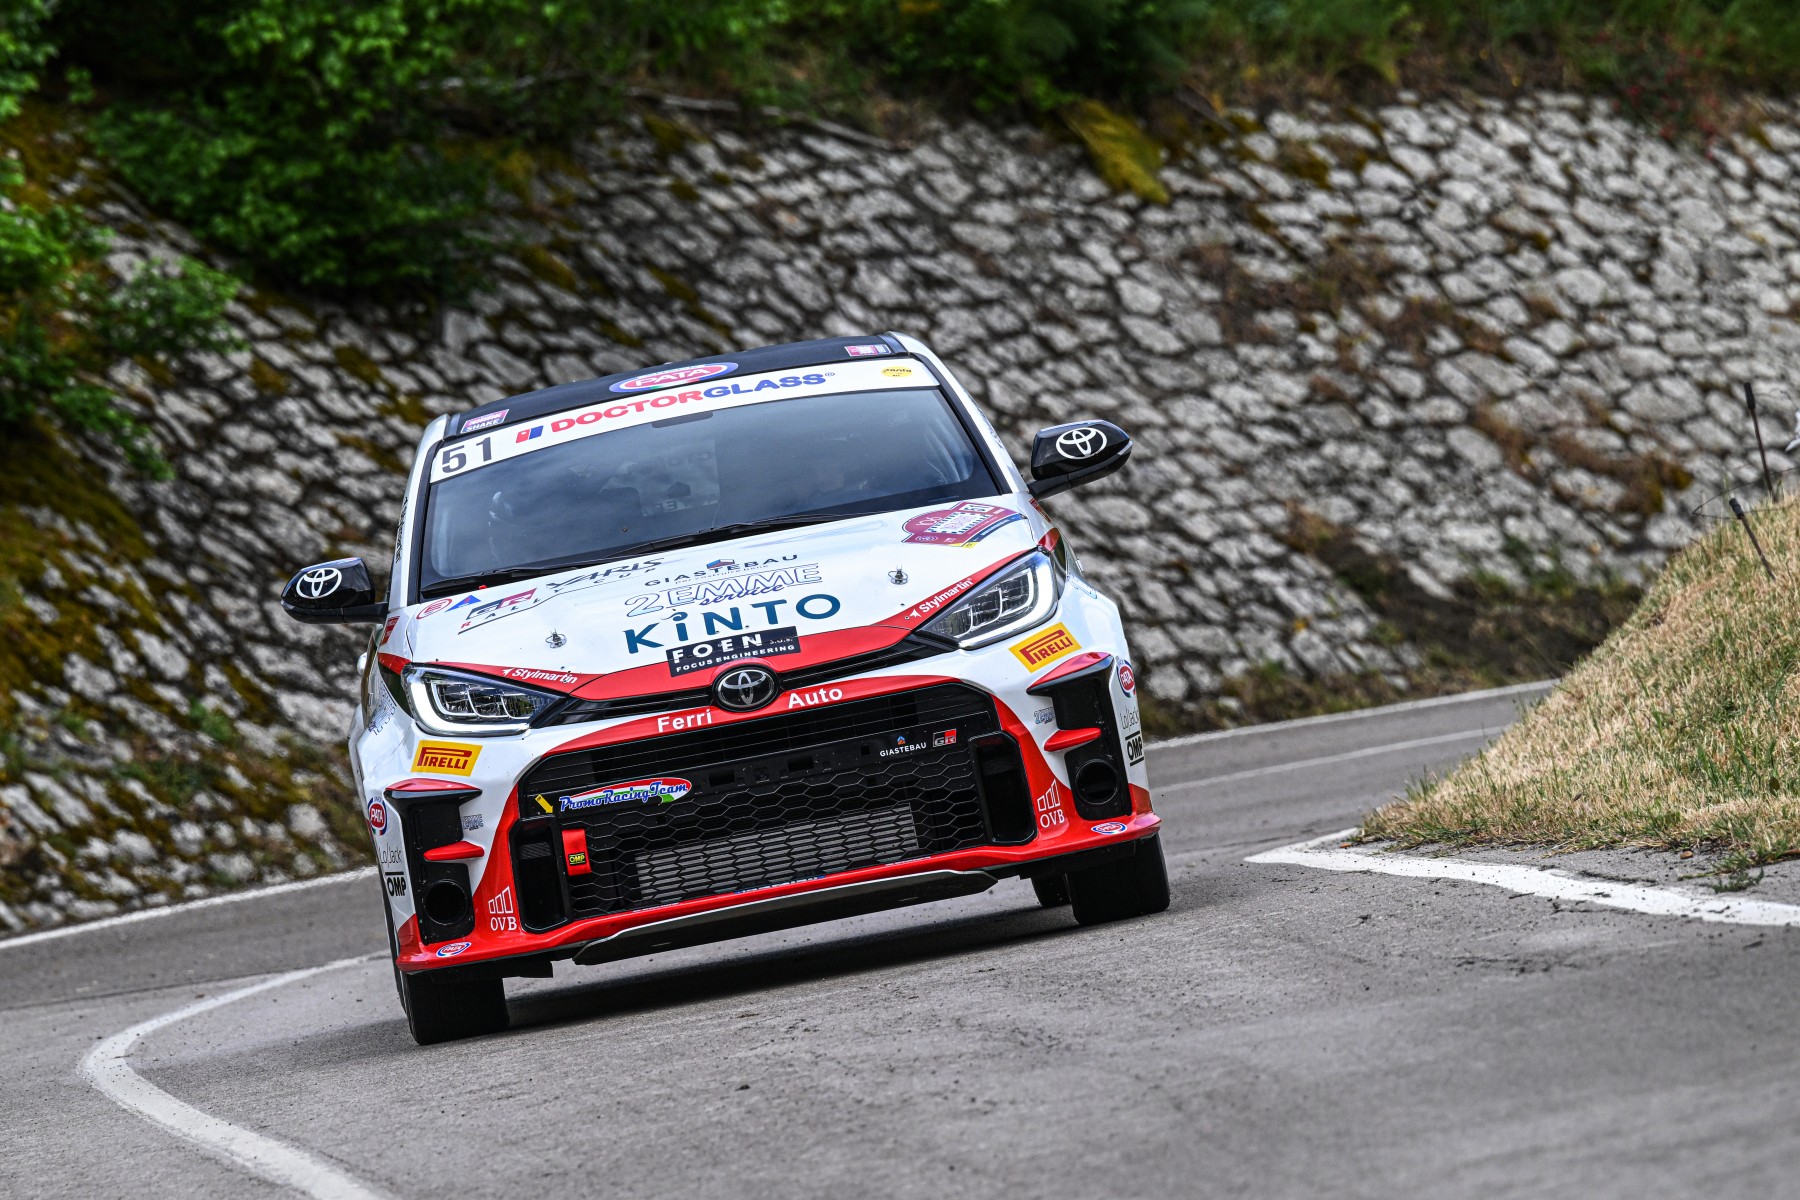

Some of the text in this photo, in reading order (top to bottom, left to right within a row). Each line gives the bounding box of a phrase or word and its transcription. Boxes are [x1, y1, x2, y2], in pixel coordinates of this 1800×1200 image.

[634, 368, 711, 386] PATA
[551, 373, 826, 433] DOCTORGLASS
[441, 436, 492, 474] 51
[644, 554, 798, 587] GIASTEBAU
[624, 562, 823, 618] 2EMME
[698, 583, 785, 606] service
[672, 633, 763, 664] FOEN
[675, 644, 795, 673] FOCUS ENGINEERING
[1018, 629, 1074, 665] PIRELLI
[511, 668, 578, 684] Stylmartin
[657, 687, 844, 733] Ferri Auto
[416, 746, 473, 770] PIRELLI
[879, 741, 927, 757] GIASTEBAU
[1126, 735, 1144, 761] OMP
[370, 807, 384, 824] PATA
[1040, 808, 1065, 828] OVB
[568, 854, 585, 863] OMP
[386, 875, 407, 897] OMP
[490, 916, 518, 931] OVB
